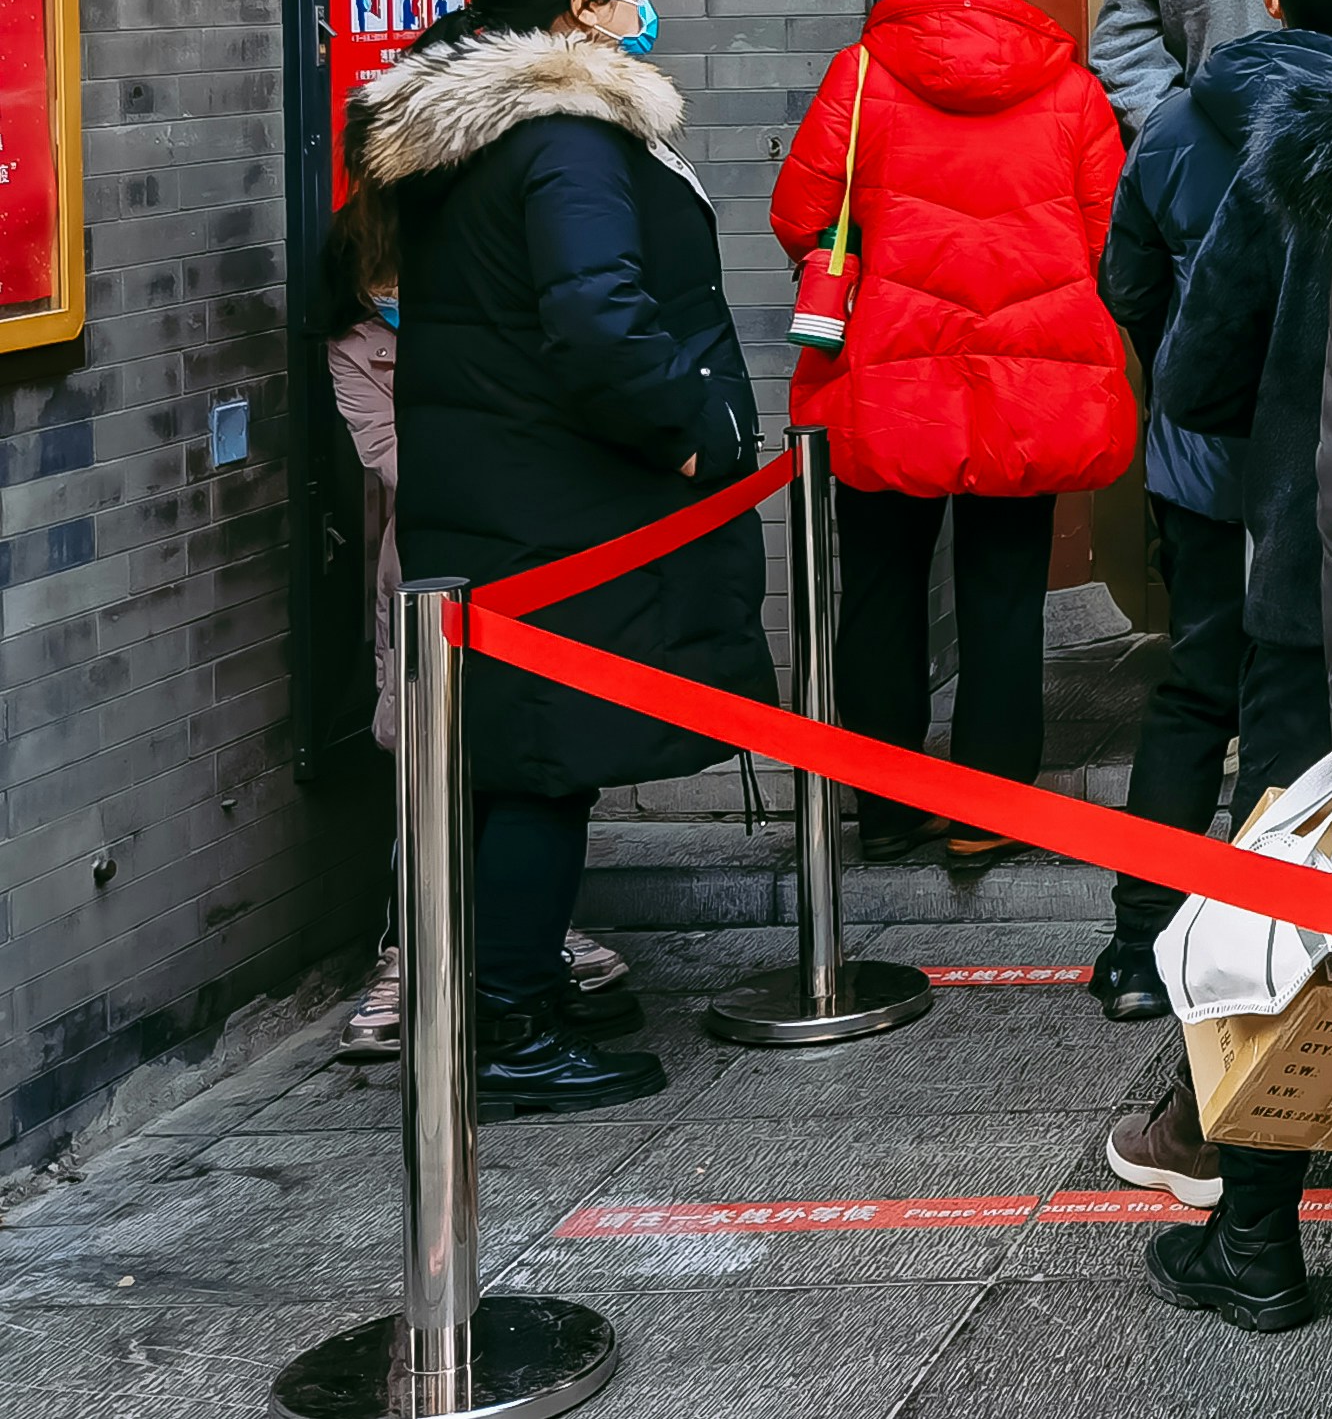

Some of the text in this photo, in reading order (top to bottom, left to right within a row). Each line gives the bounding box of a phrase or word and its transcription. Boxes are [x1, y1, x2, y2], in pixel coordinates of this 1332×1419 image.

[595, 1204, 880, 1229] 请在一米线外等候
[904, 1206, 976, 1220] Please
[983, 1204, 1031, 1218] wait
[1039, 1200, 1121, 1216] outside
[1127, 1199, 1161, 1214] the
